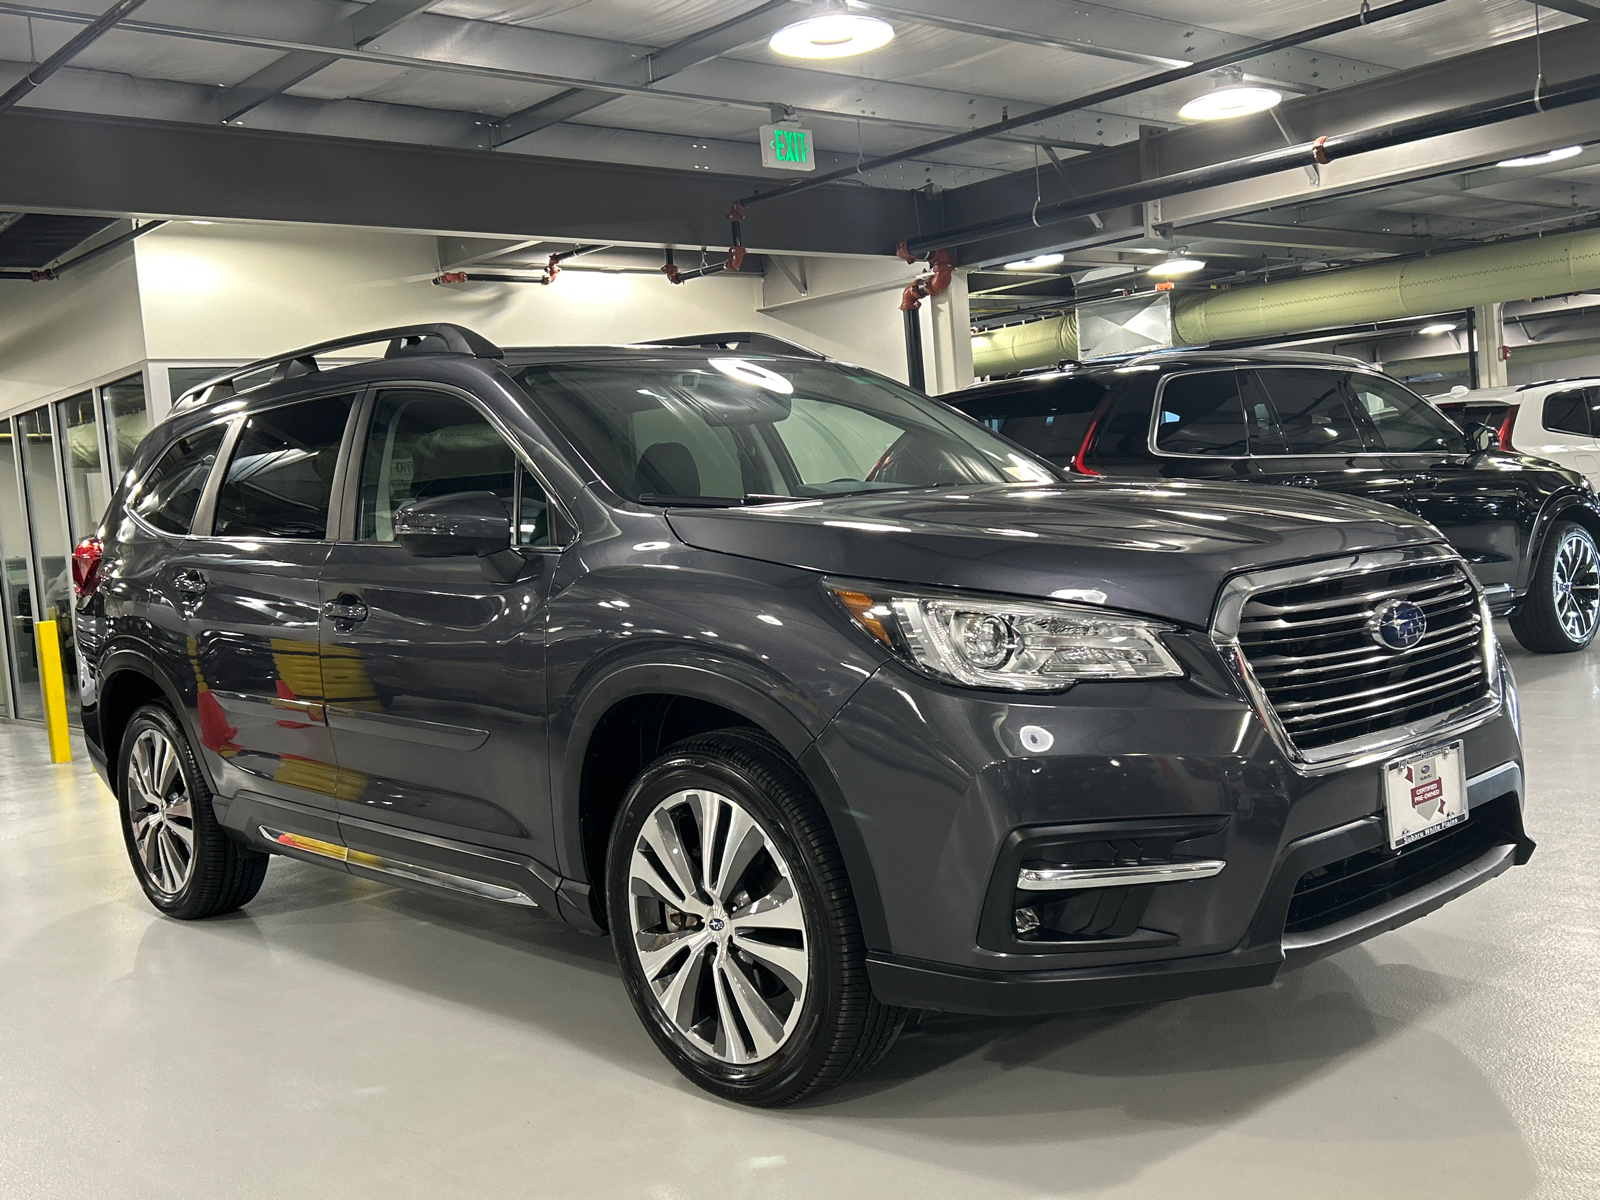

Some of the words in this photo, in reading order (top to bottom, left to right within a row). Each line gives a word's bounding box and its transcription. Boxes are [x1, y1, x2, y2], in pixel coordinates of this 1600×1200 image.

[774, 129, 805, 163] EXIT
[1414, 789, 1440, 803] PRE-OWNED
[1415, 783, 1438, 796] CERTIFIED
[1403, 831, 1424, 843] Subaru
[1424, 824, 1441, 836] White
[1441, 817, 1458, 831] Plains
